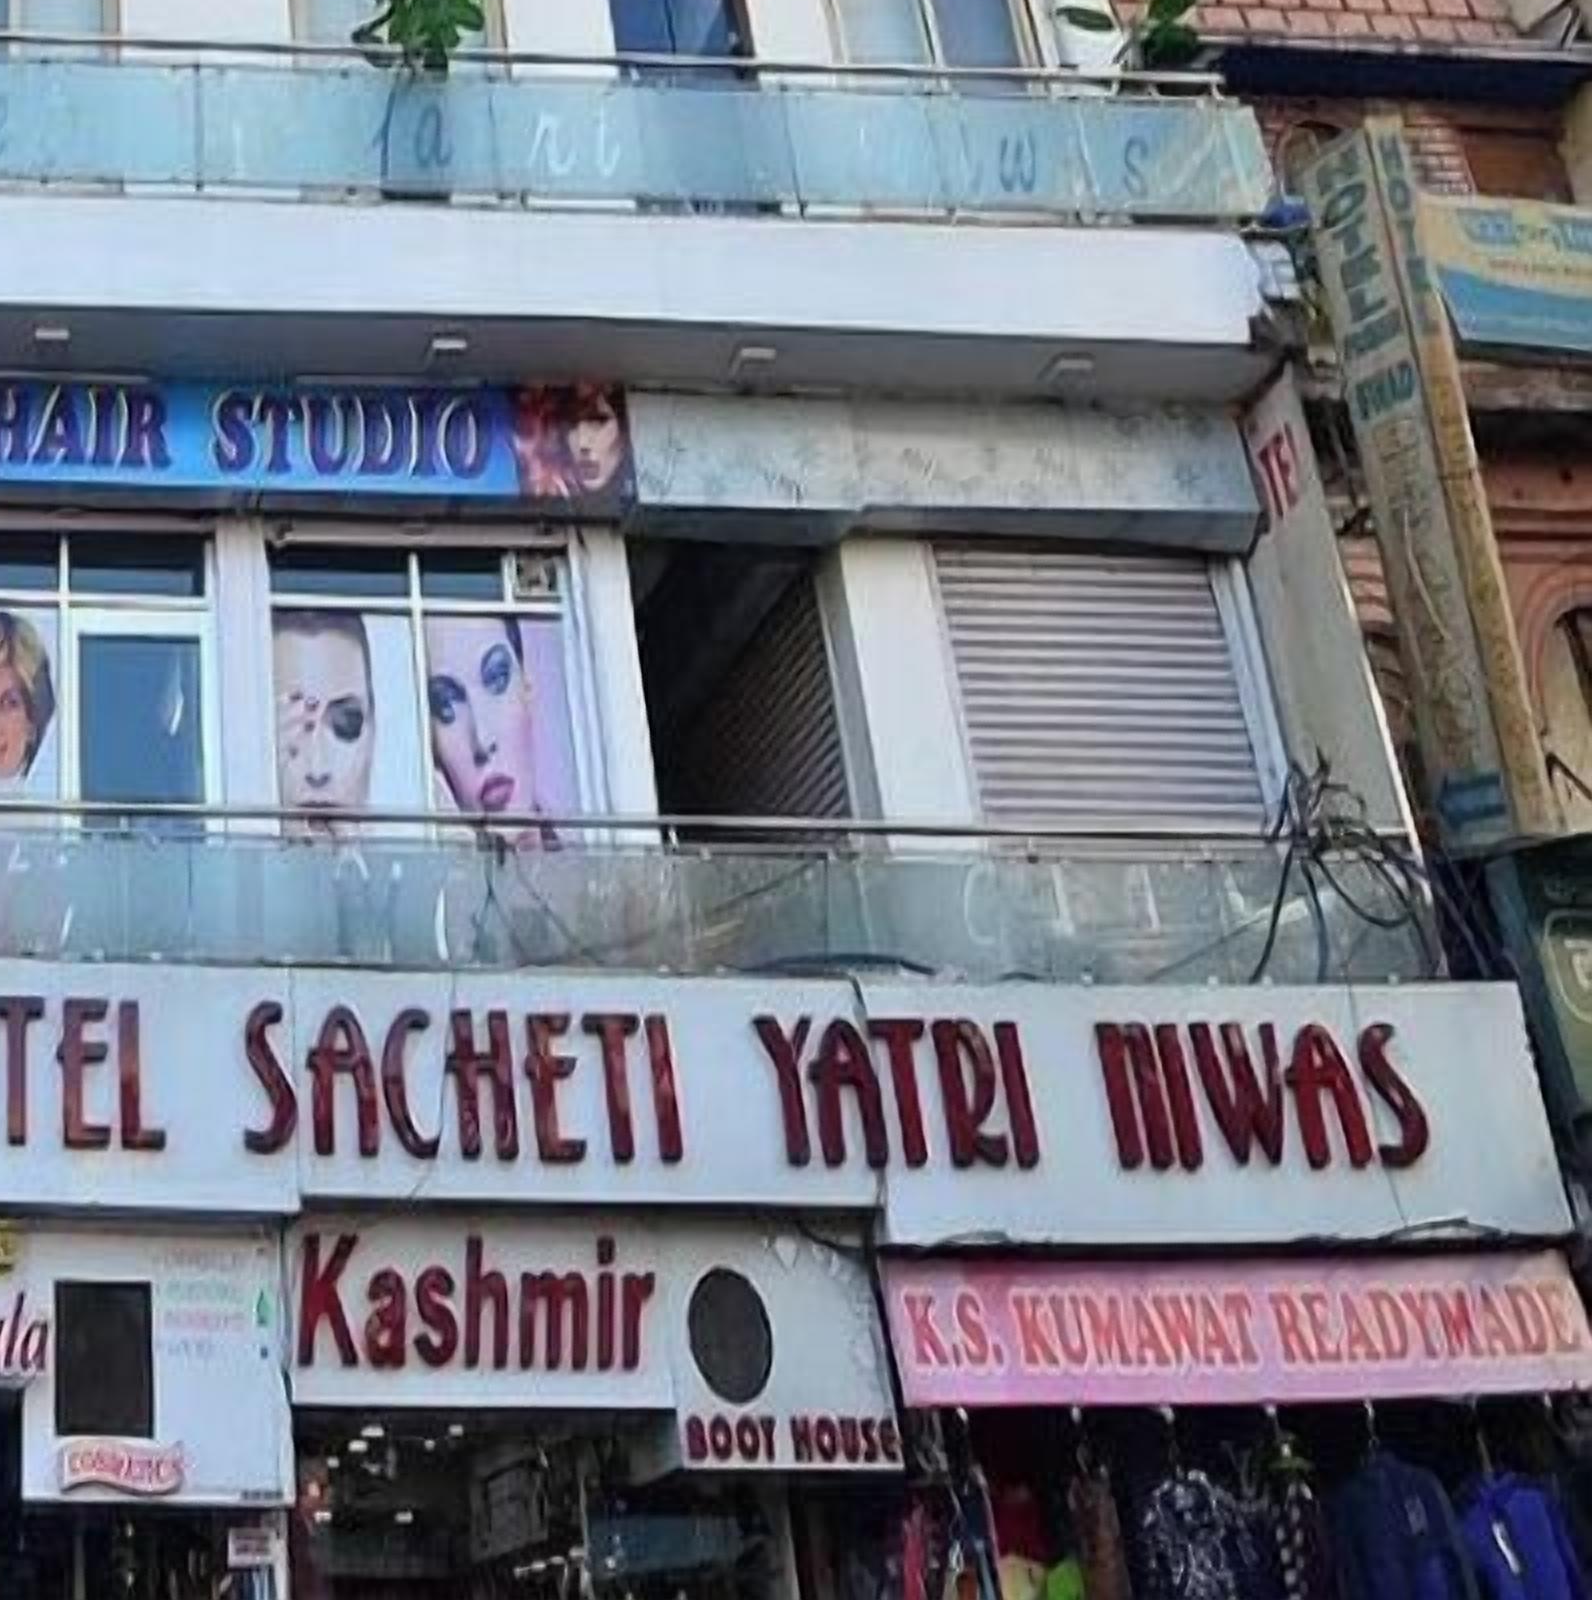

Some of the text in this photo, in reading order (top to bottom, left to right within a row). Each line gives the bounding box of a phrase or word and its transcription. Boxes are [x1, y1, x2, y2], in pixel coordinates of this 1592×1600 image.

[212, 390, 491, 478] STUDIO
[244, 1000, 685, 1166] SACHETI
[752, 1014, 1040, 1170] YATRI
[1094, 1020, 1430, 1172] NIWAS
[296, 1232, 656, 1372] Kashmir
[1012, 1288, 1259, 1368] KUMAWAT
[1268, 1284, 1582, 1366] READYMADE
[790, 1414, 904, 1466] HOUSE
